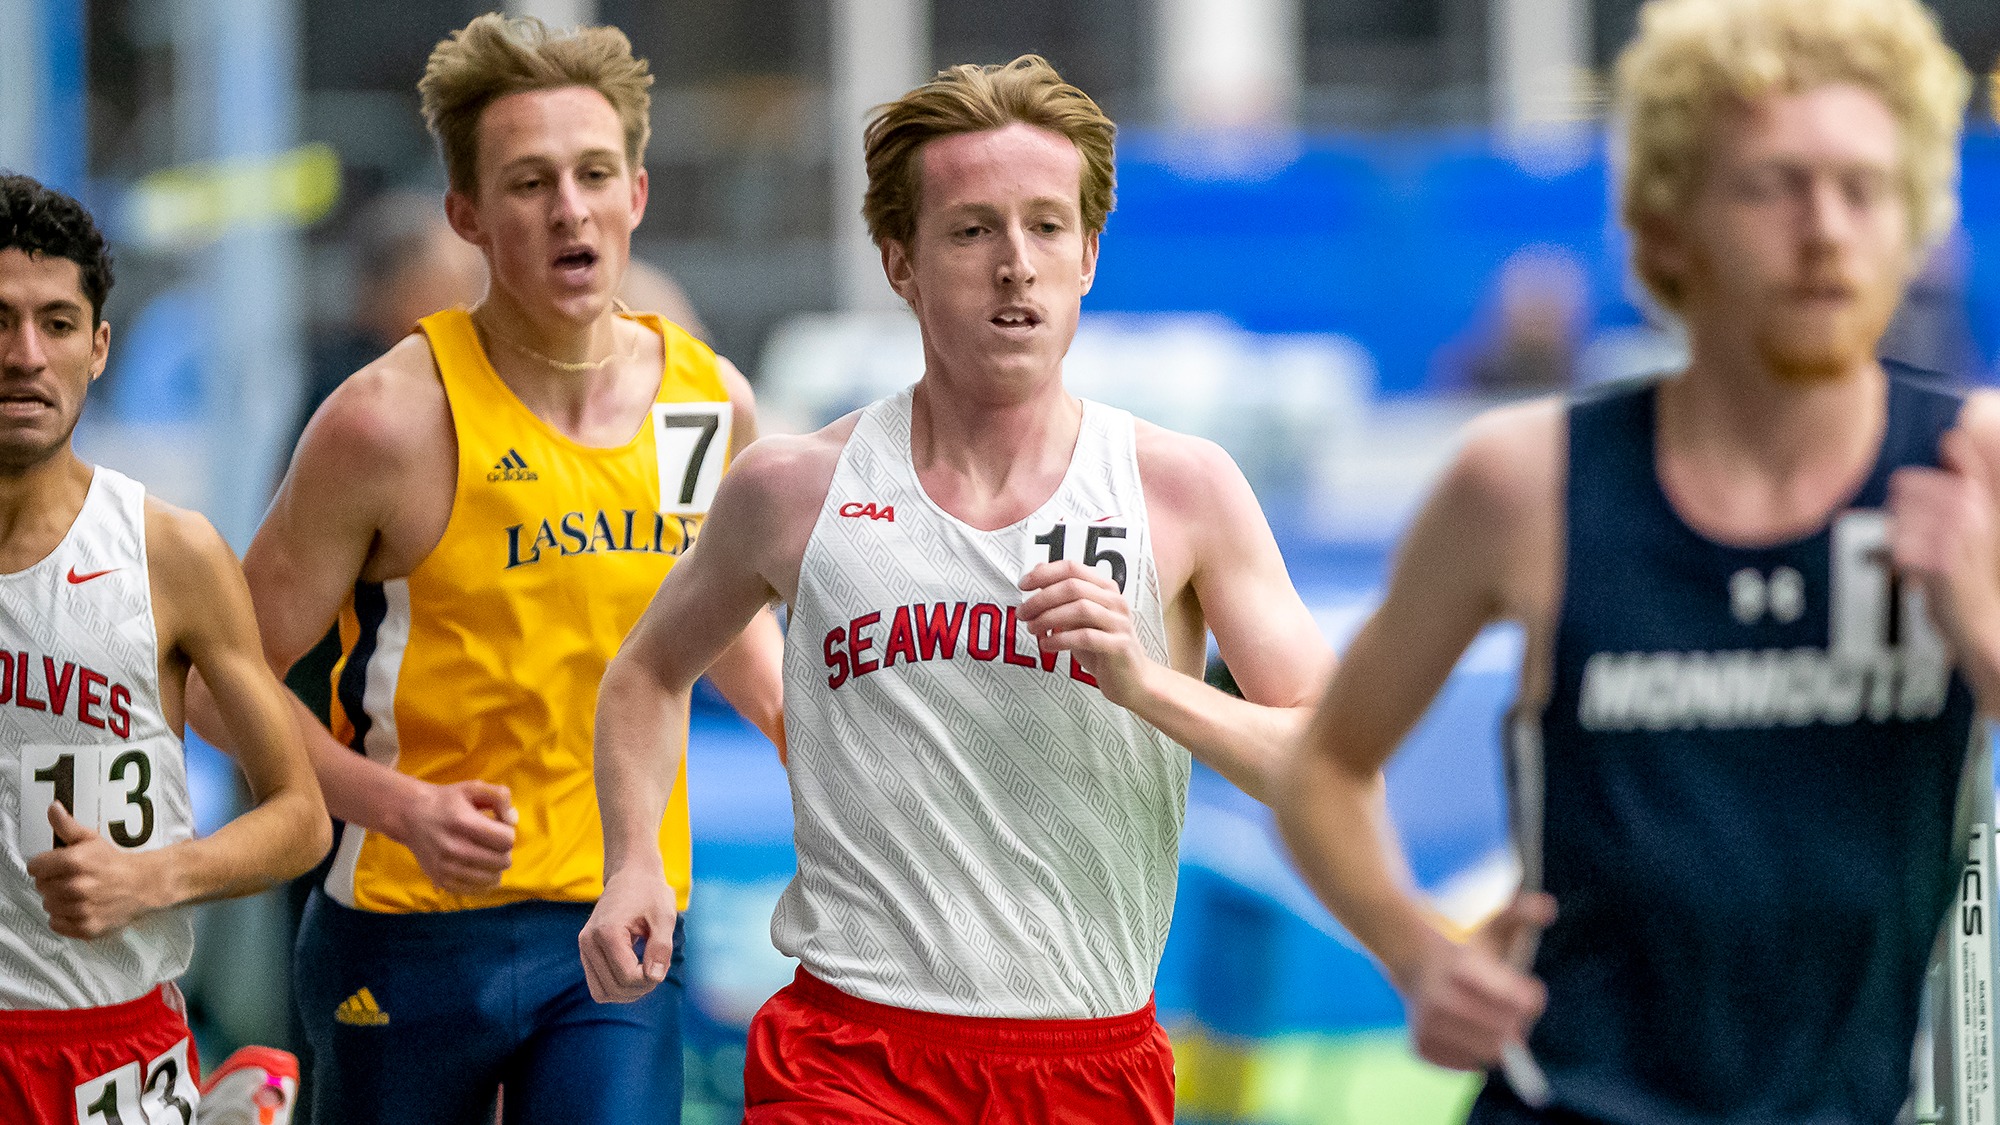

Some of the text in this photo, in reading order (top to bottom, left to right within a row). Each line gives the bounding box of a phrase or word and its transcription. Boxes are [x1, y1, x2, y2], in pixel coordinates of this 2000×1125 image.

[486, 466, 539, 482] adidas
[664, 413, 719, 505] 7
[839, 502, 895, 522] CAA
[1034, 523, 1128, 595] 15
[823, 601, 1099, 690] SEAWOL
[34, 748, 154, 850] 13
[87, 1056, 192, 1125] 13
